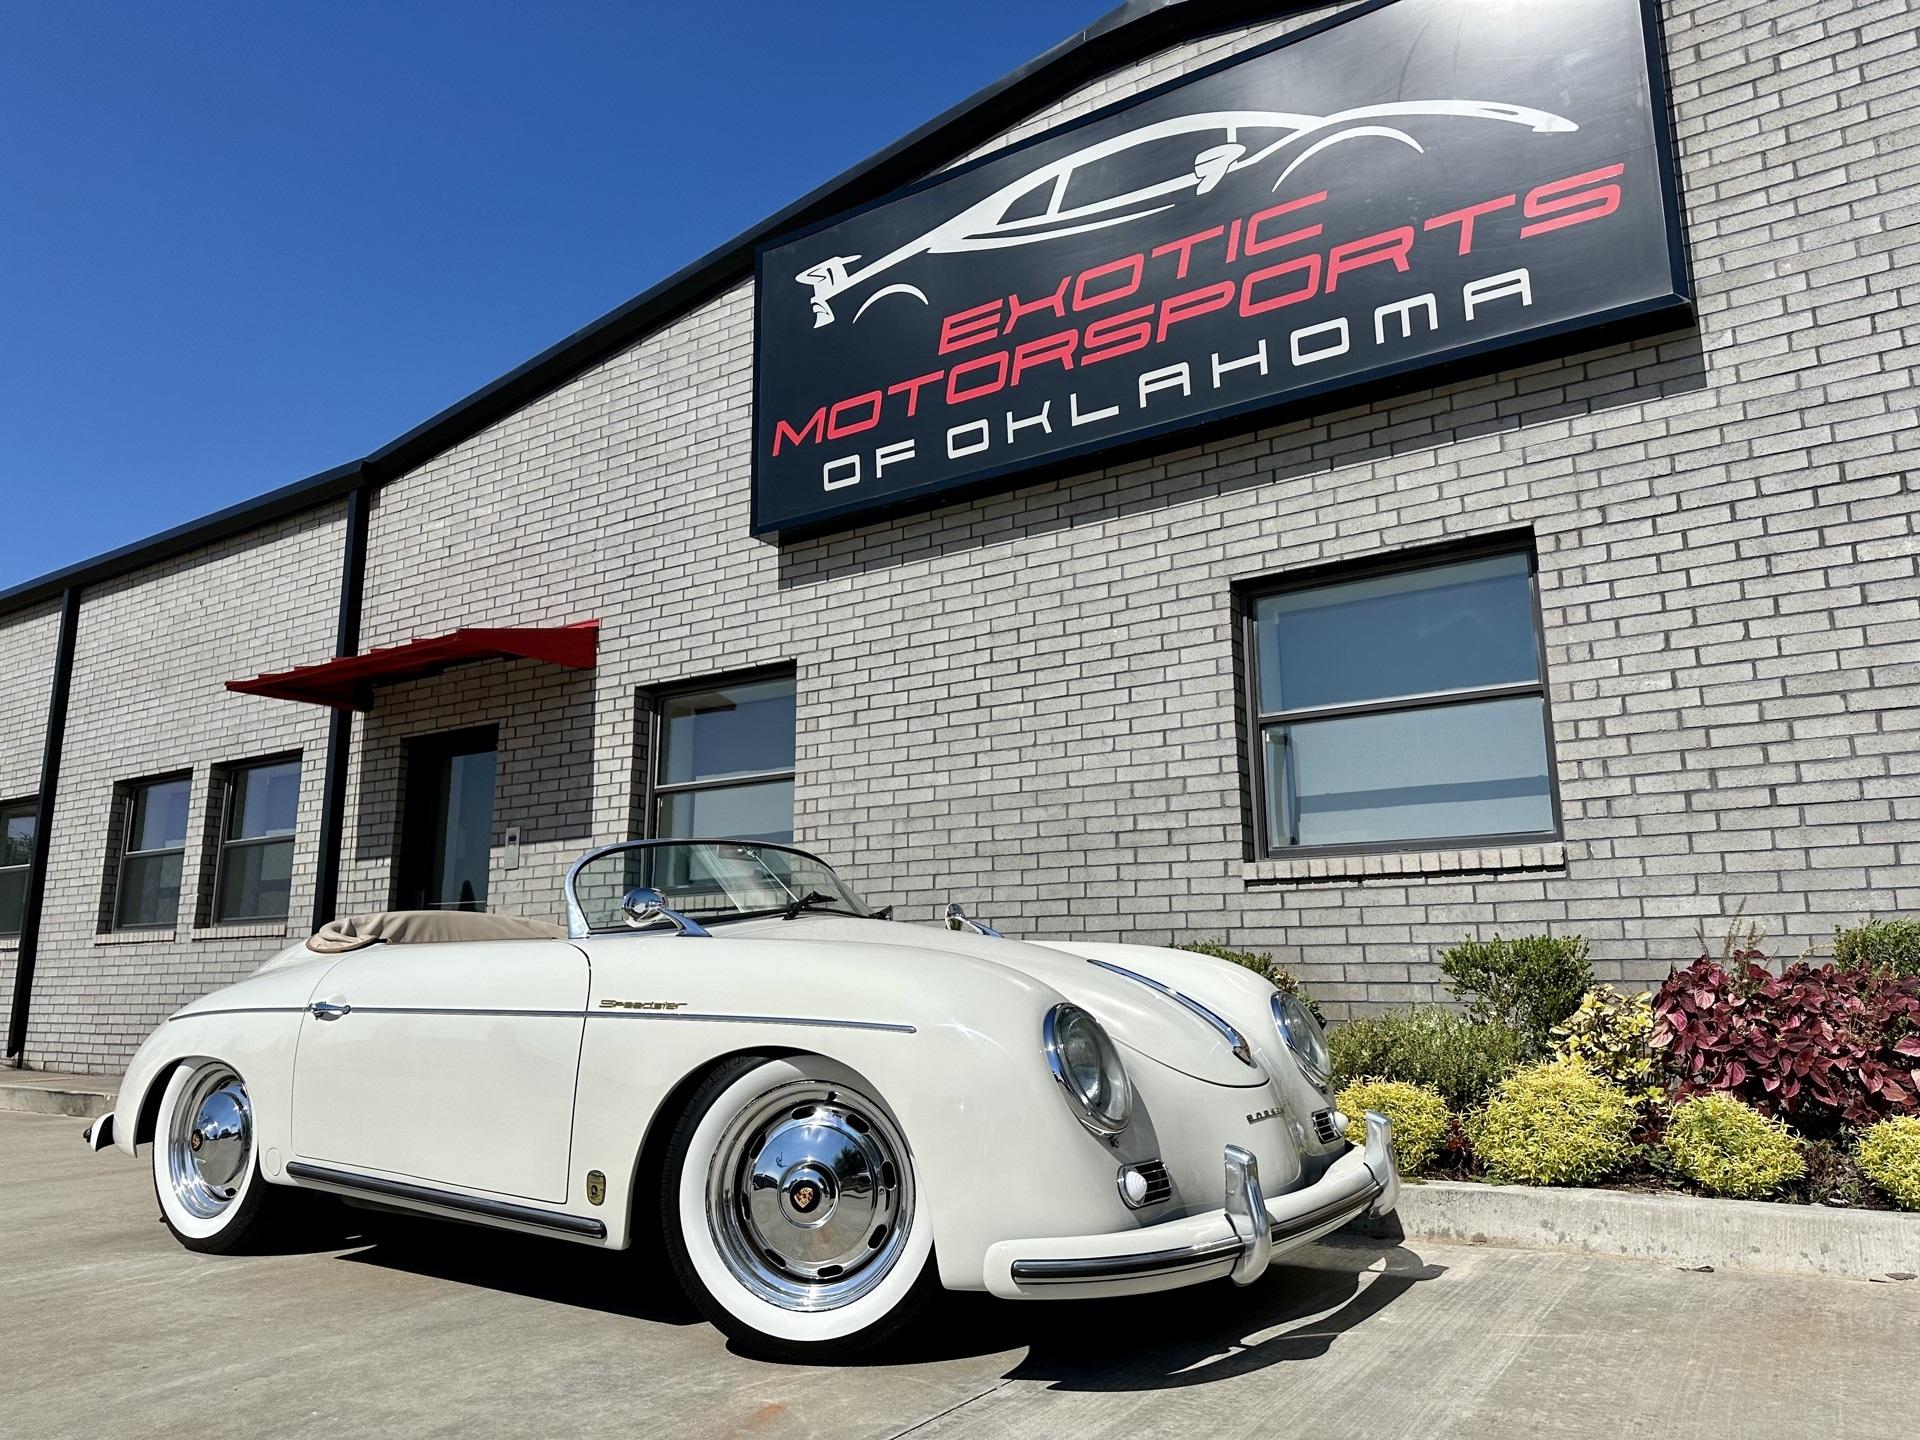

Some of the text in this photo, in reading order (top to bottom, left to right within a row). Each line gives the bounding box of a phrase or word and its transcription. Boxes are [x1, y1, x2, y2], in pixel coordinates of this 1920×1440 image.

[772, 163, 1626, 458] MOTORSPORTS
[823, 267, 1533, 492] OF OKLAHOMA
[937, 190, 1327, 355] EXOTIC
